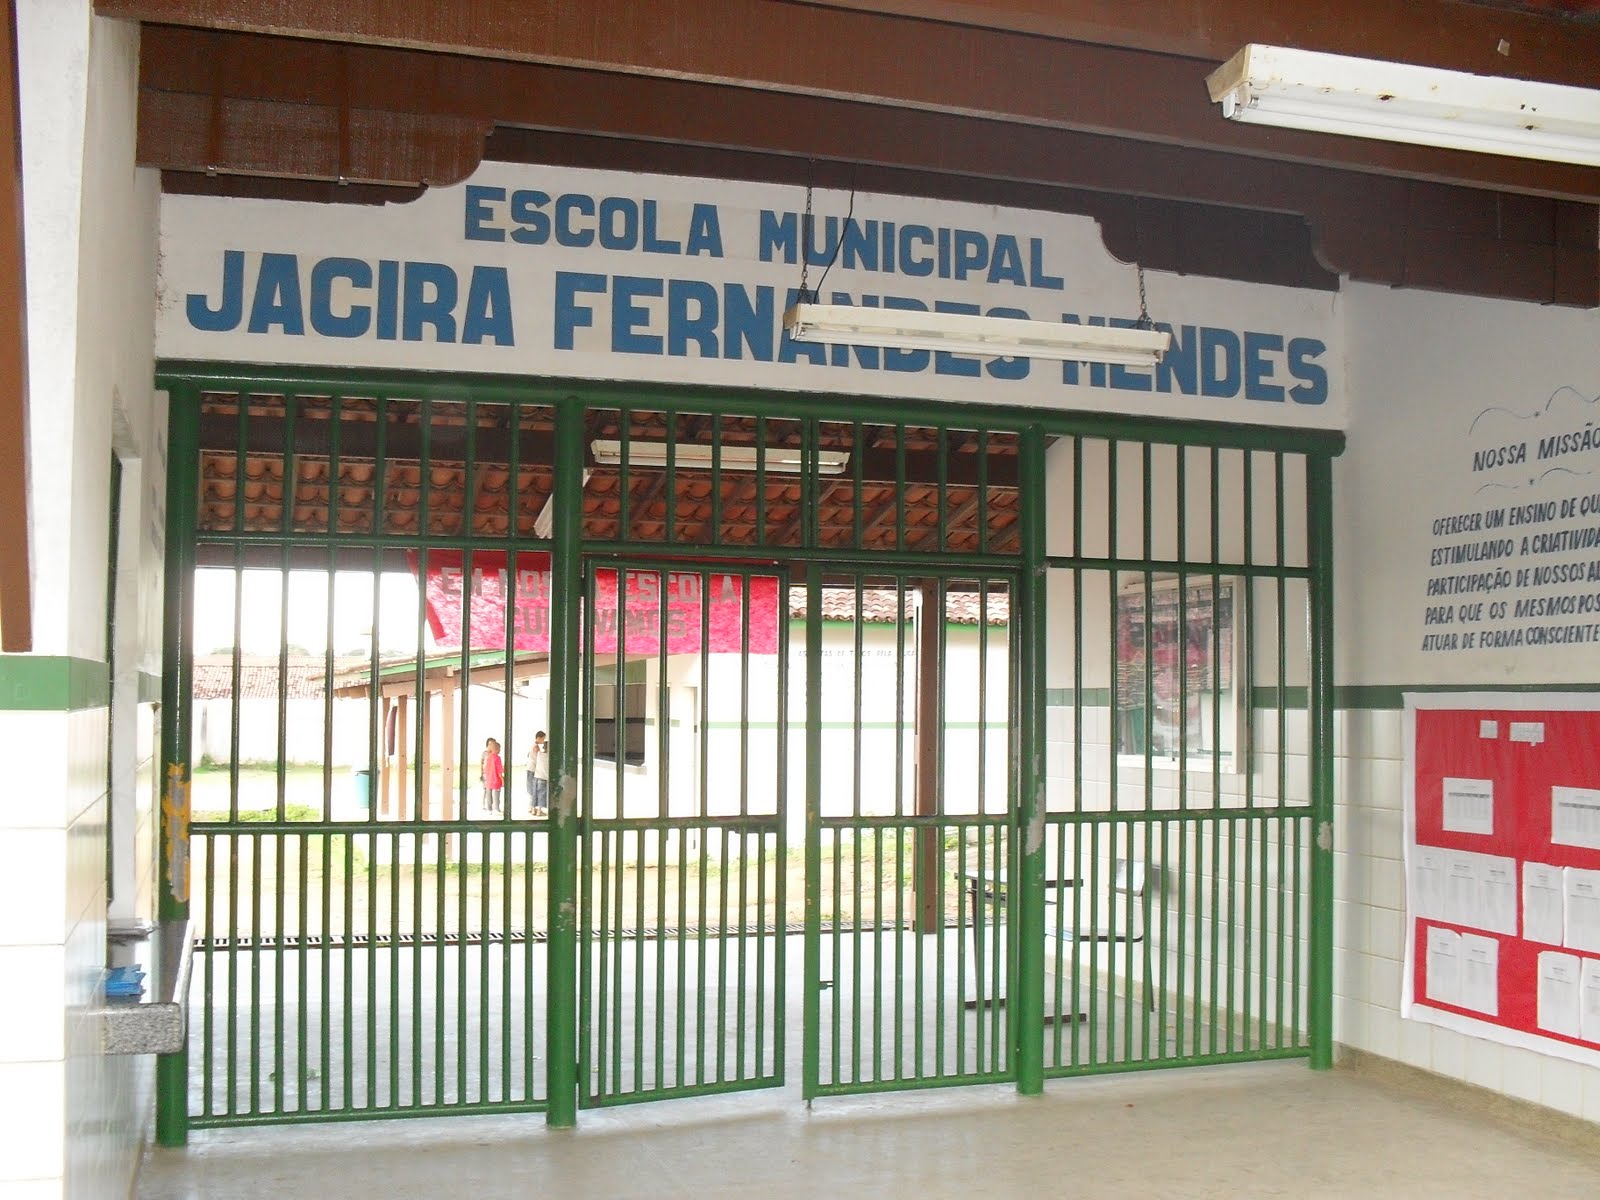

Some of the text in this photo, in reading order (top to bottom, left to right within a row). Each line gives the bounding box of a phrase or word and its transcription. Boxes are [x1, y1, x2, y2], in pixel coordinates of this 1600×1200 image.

[465, 184, 1064, 291] ESCOLA MUNICIPAL
[186, 249, 515, 348] JACIRA
[1472, 442, 1527, 472] NOSSA
[1432, 512, 1483, 537] OFERECER
[1485, 508, 1505, 530] UM
[1508, 501, 1557, 526] ENSINO
[1560, 497, 1578, 519] DE
[1430, 539, 1514, 567] ESTIMULANDO
[1520, 536, 1529, 556] A
[1426, 567, 1512, 596] PARTICIPAÇÃO
[1516, 568, 1531, 588] DE
[1533, 561, 1586, 587] NOSSOS
[1424, 605, 1454, 626] PARA
[1458, 602, 1484, 624] QUE
[1489, 601, 1508, 620] OS
[1514, 595, 1577, 618] MESMOS
[1422, 633, 1459, 651] ATUAR
[1462, 632, 1476, 649] DE
[1479, 628, 1524, 649] FORMA
